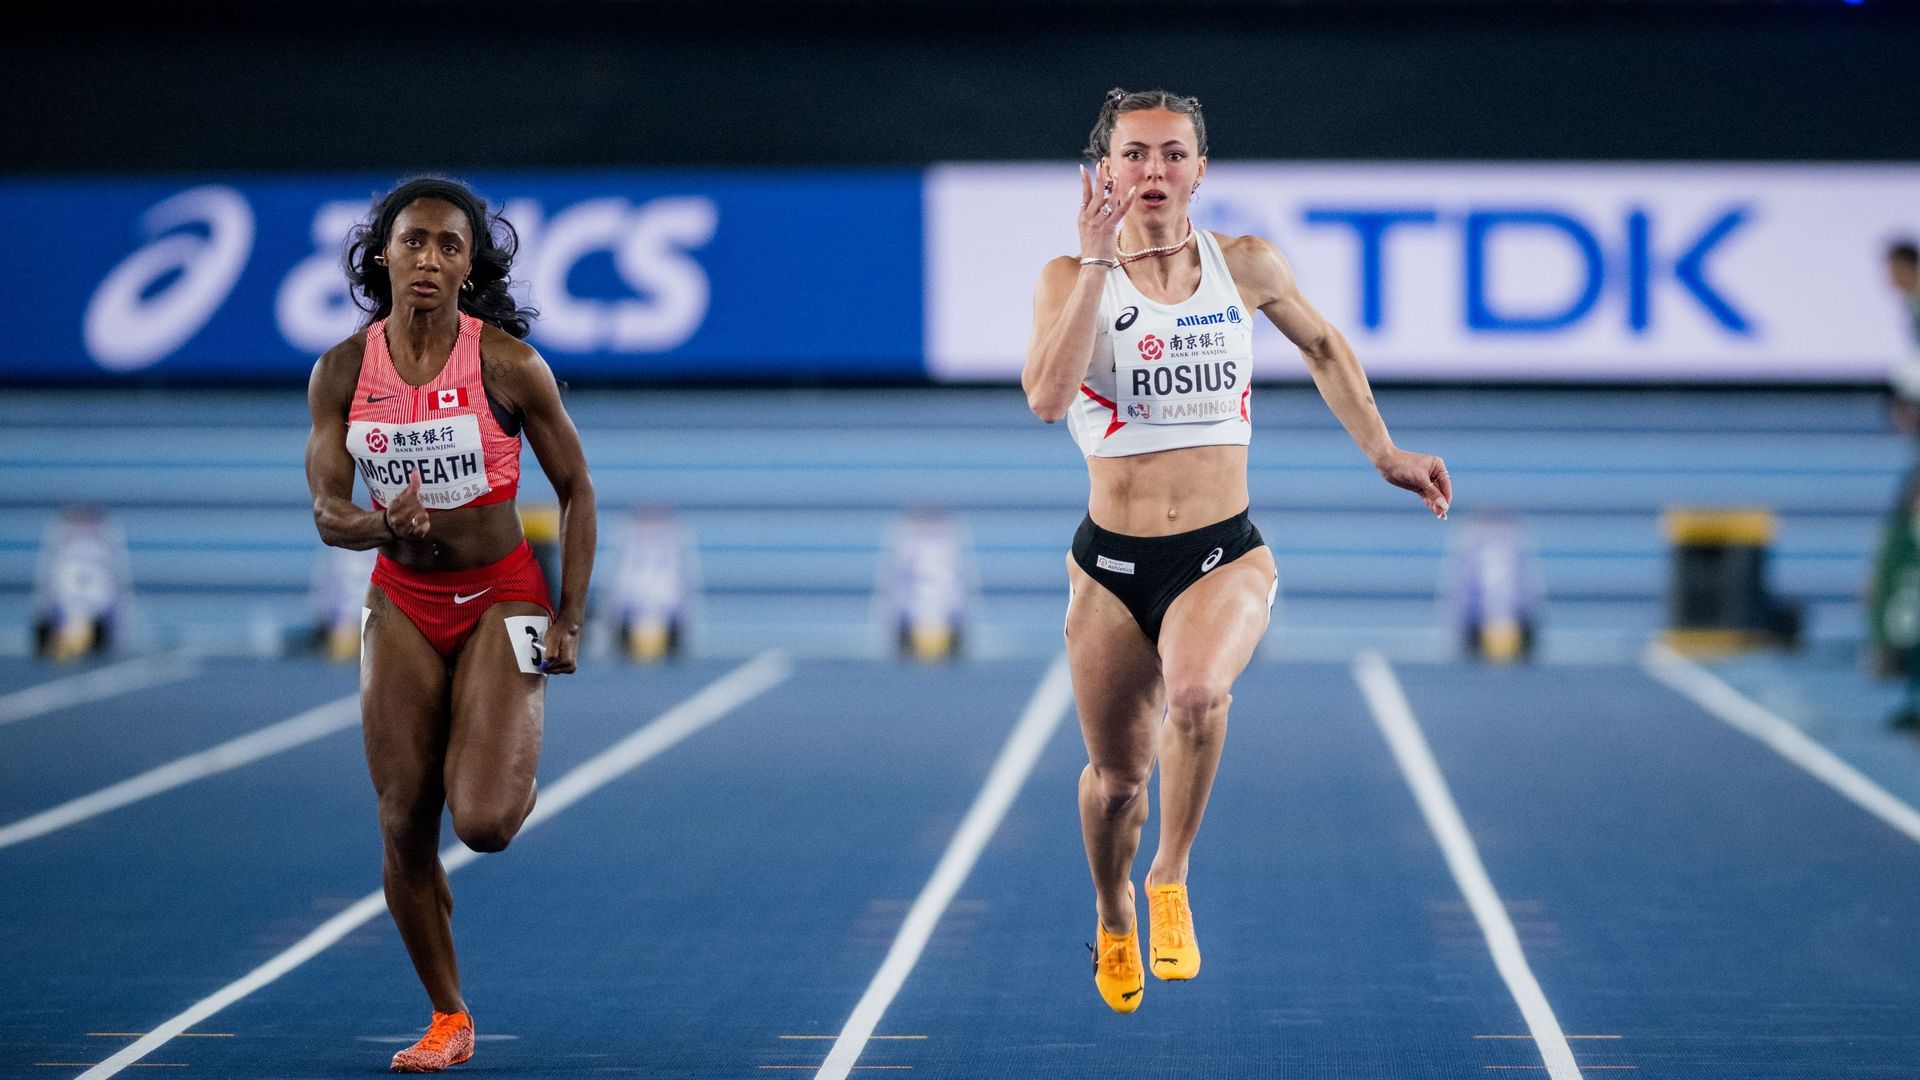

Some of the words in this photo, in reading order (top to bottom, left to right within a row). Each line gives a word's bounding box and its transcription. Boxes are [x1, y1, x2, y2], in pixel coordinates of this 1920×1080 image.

[1304, 206, 1753, 333] TDK
[1176, 313, 1225, 326] Allianz
[1169, 332, 1226, 350] 南京银行
[1170, 351, 1190, 359] BANK
[1201, 349, 1228, 357] NANJING
[1132, 361, 1237, 396] ROSIUS
[392, 426, 454, 447] 南京银行
[426, 443, 456, 452] NANJING
[525, 626, 541, 666] 3
